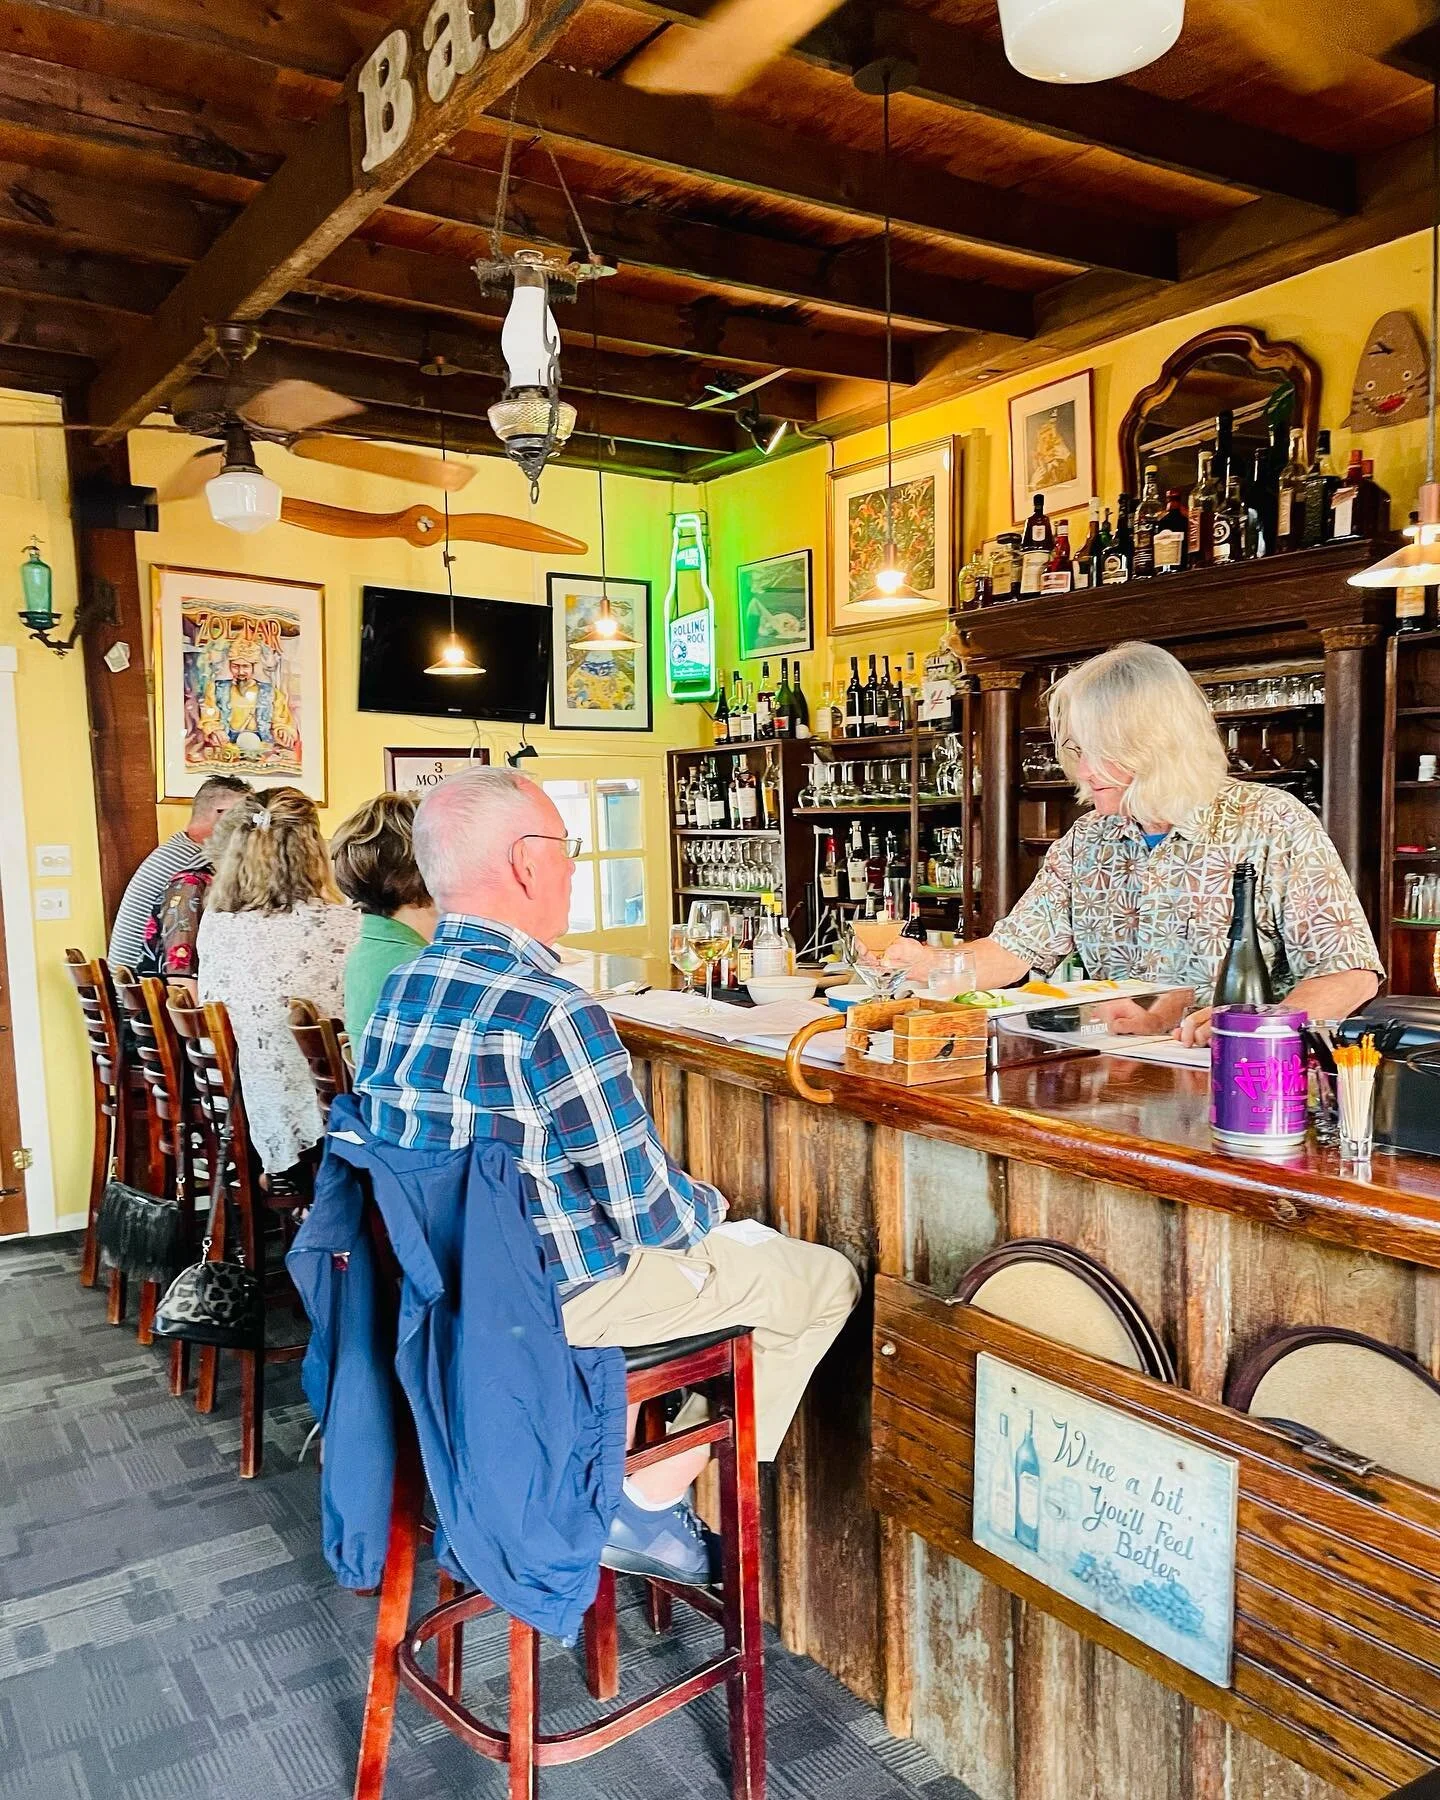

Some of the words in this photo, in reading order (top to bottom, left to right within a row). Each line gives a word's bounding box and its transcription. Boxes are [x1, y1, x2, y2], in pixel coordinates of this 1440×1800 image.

[194, 612, 283, 656] ZOLTAR
[673, 618, 705, 636] ROLLING
[687, 633, 705, 643] ROCK
[415, 774, 452, 786] MON
[434, 761, 443, 774] 3
[1051, 1415, 1117, 1483] Wine
[1125, 1477, 1141, 1496] a
[1114, 1528, 1182, 1582] Better
[1154, 1519, 1195, 1561] Feel
